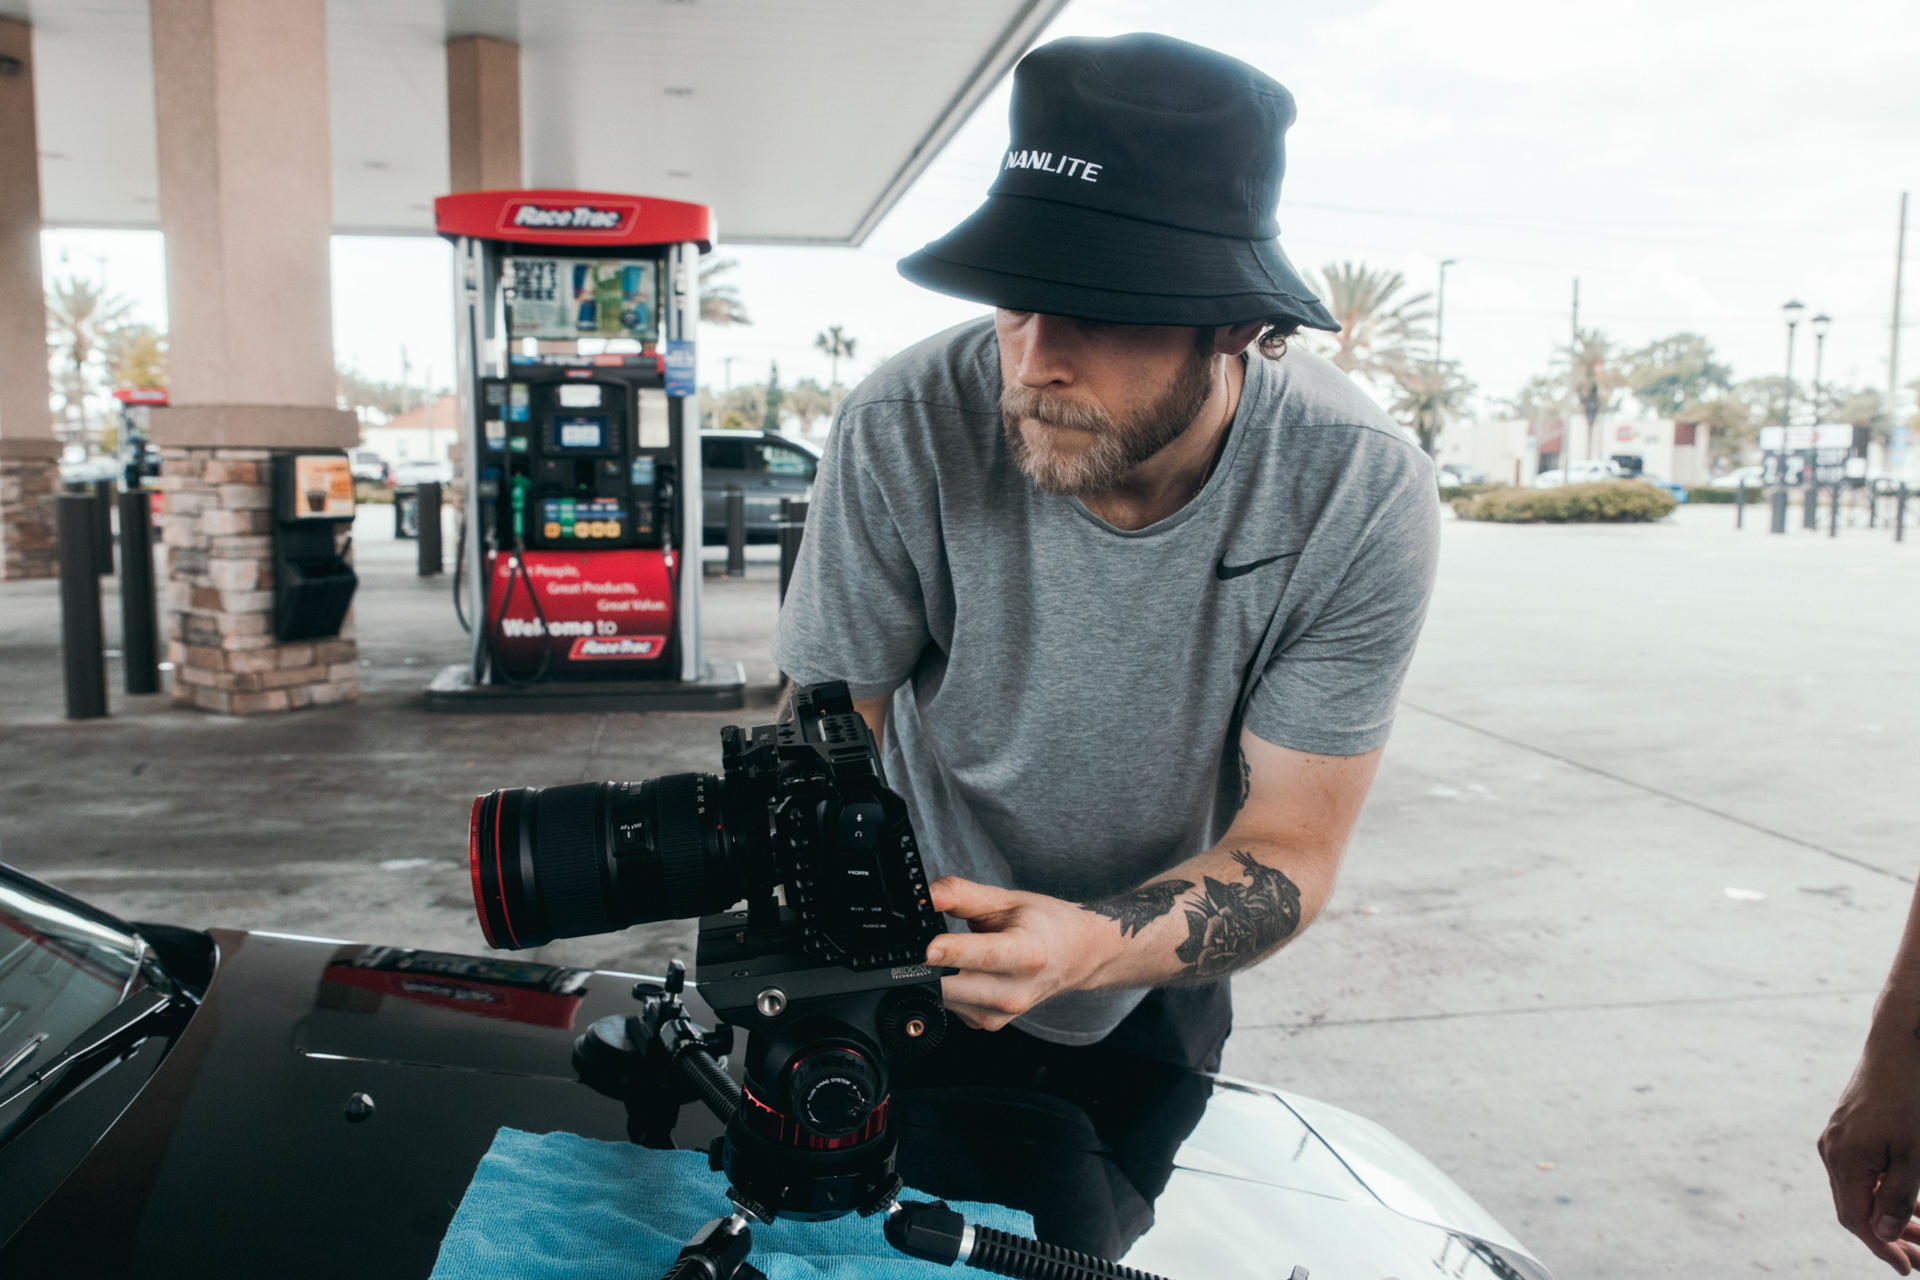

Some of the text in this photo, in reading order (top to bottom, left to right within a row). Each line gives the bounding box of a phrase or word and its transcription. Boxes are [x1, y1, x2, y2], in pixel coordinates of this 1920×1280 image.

[1004, 150, 1103, 182] NANLITE
[513, 204, 622, 229] RaceTrac
[546, 582, 580, 595] Great
[597, 599, 630, 612] Great
[596, 619, 617, 636] to
[847, 869, 870, 877] HDMI
